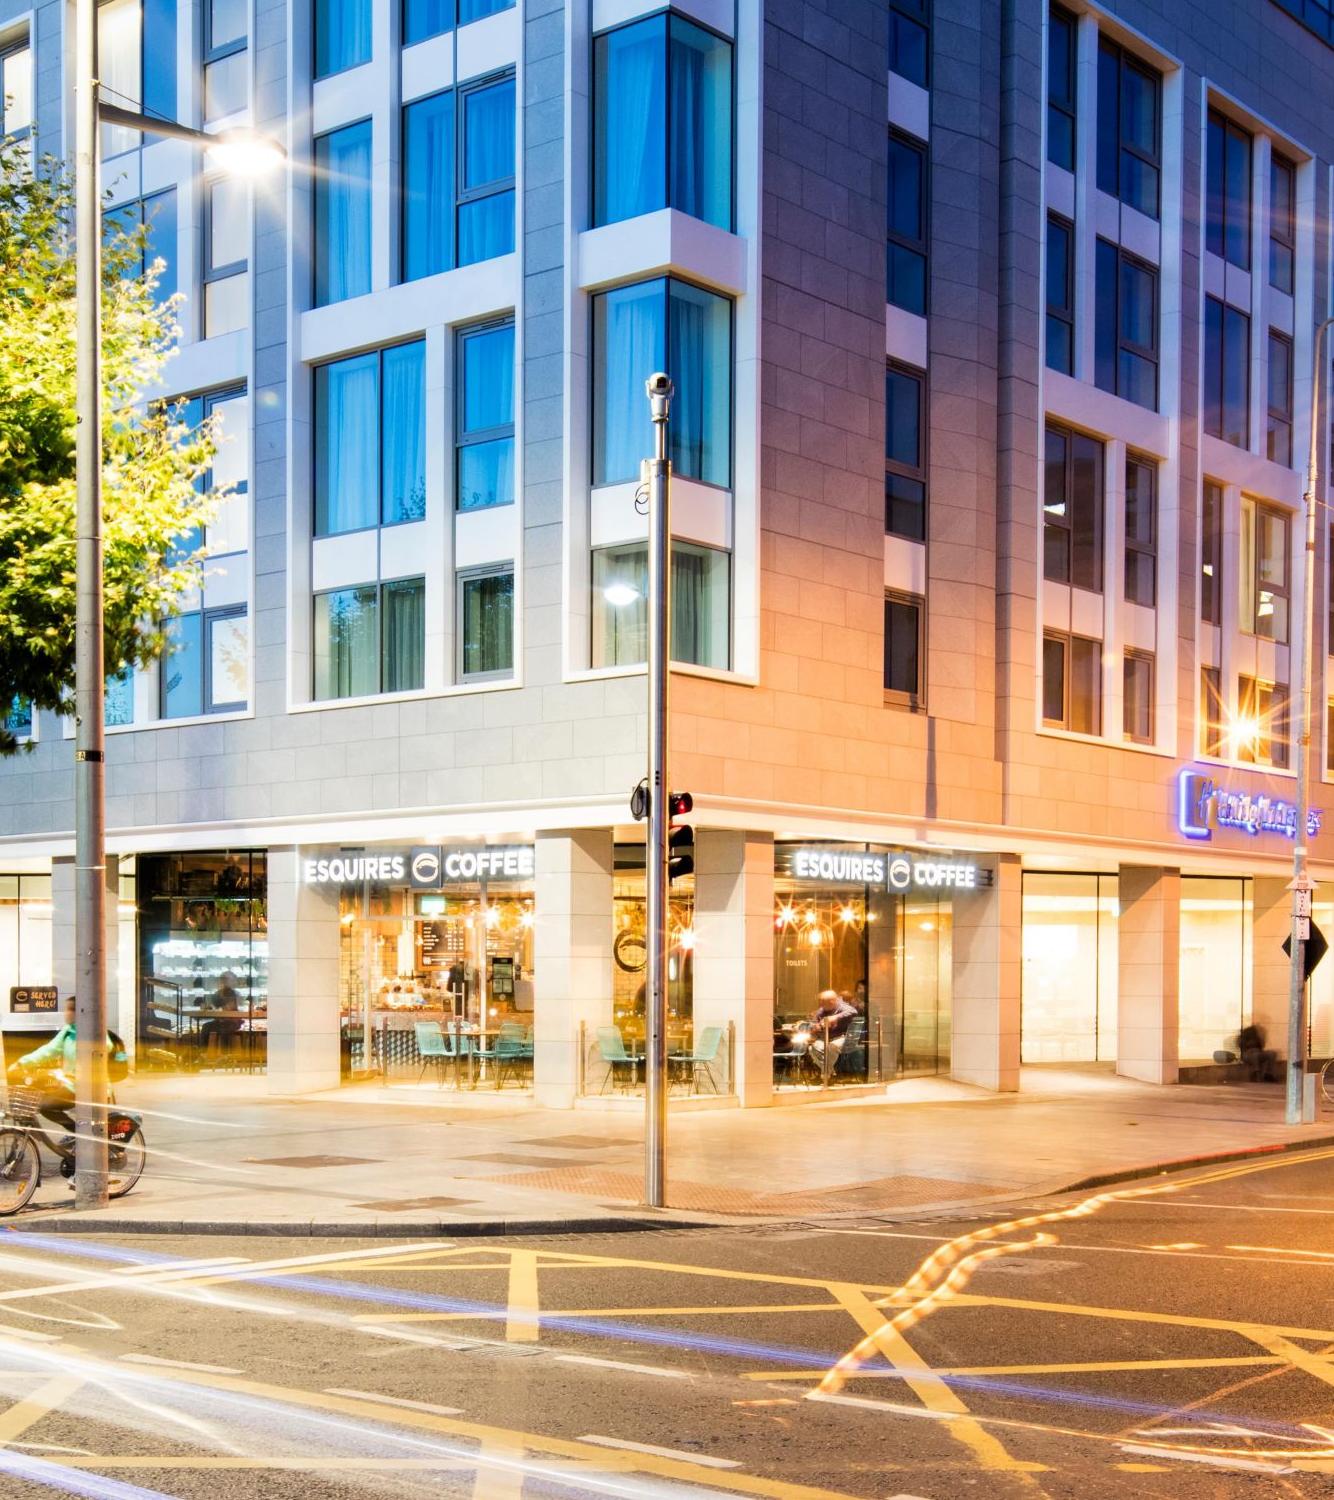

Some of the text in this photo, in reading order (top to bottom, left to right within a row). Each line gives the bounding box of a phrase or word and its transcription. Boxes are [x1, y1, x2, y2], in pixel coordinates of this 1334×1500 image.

[304, 849, 534, 883] ESQUIRES COFFEE
[795, 852, 975, 887] ESQUIRES COFFEE
[786, 959, 808, 967] TOILETS
[30, 990, 57, 999] SERVED
[35, 1000, 56, 1008] HERE!
